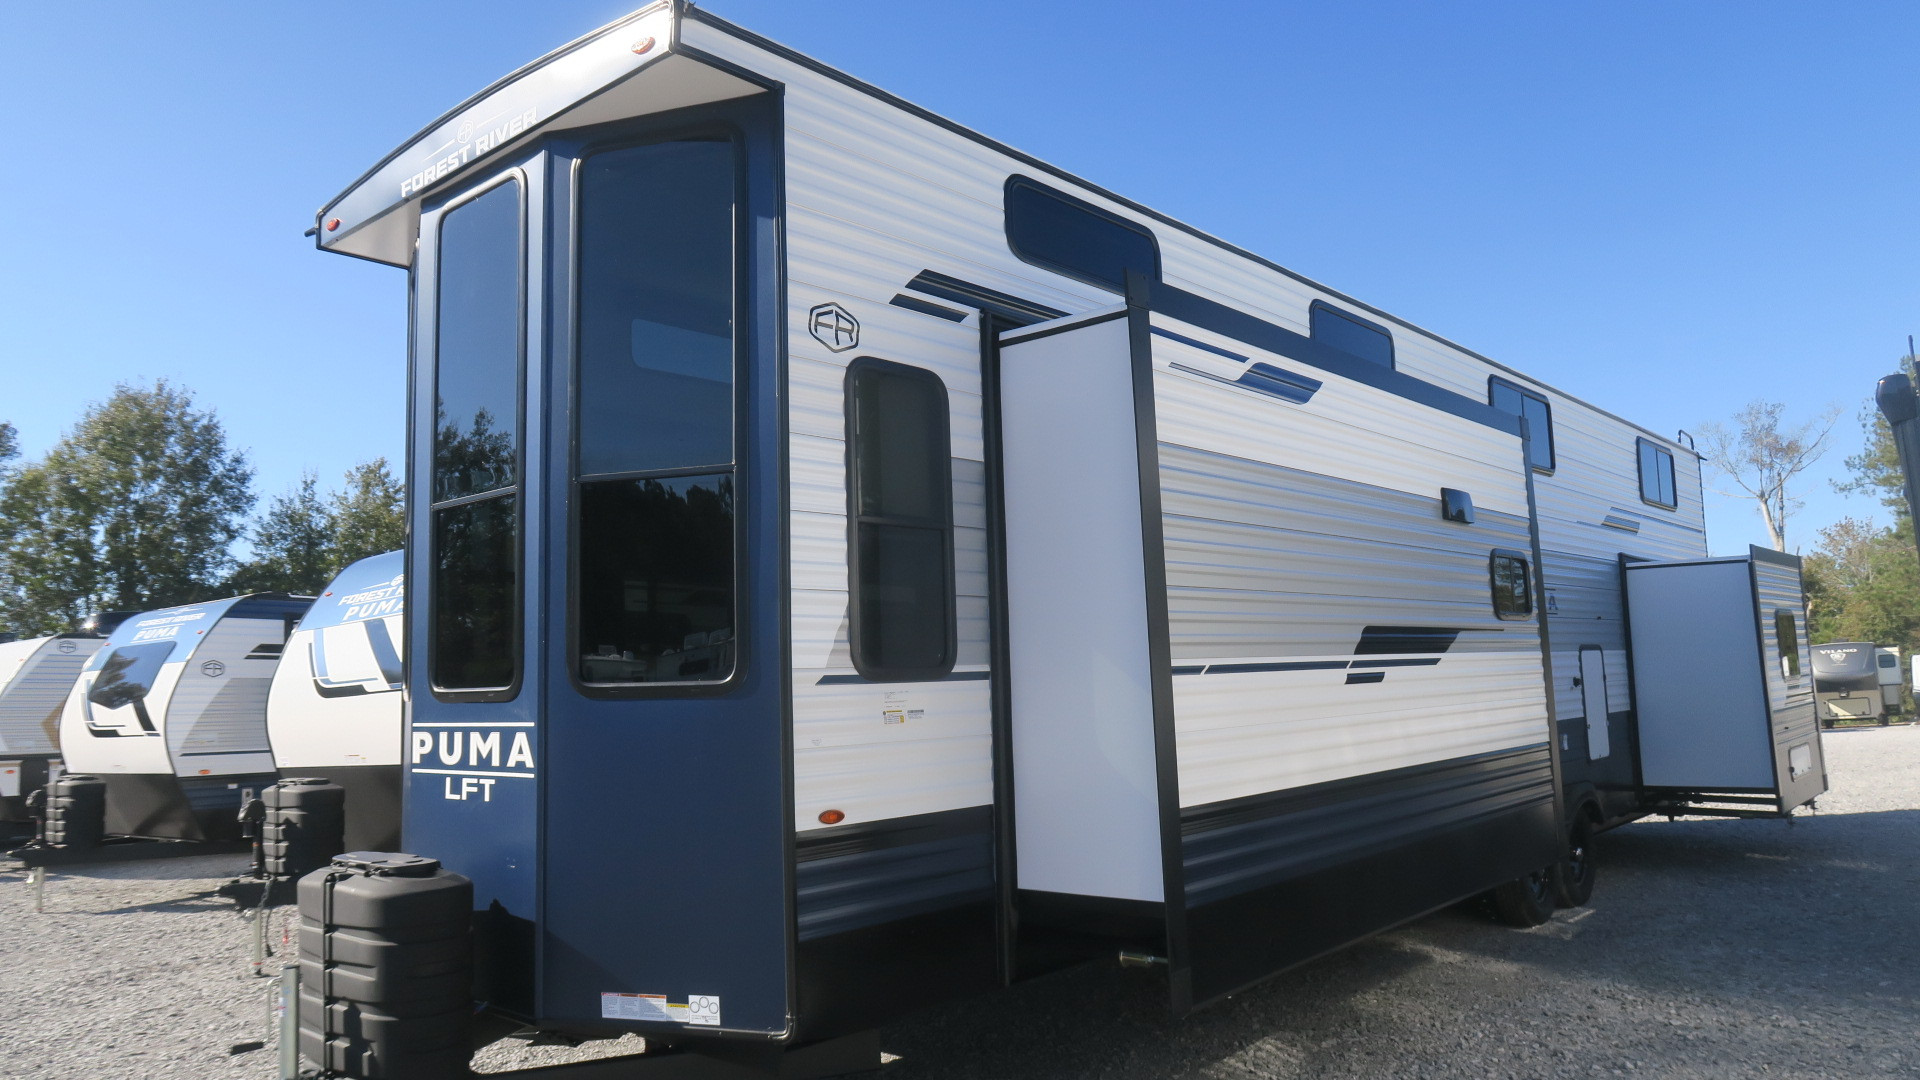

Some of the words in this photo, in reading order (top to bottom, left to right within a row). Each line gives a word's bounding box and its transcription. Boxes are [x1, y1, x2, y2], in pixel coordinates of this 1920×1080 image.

[400, 144, 472, 198] FOREST
[474, 106, 538, 156] RIVER
[338, 586, 398, 606] FOREST
[133, 626, 179, 640] PUMA
[411, 731, 535, 768] PUMA
[445, 776, 496, 802] LFT
